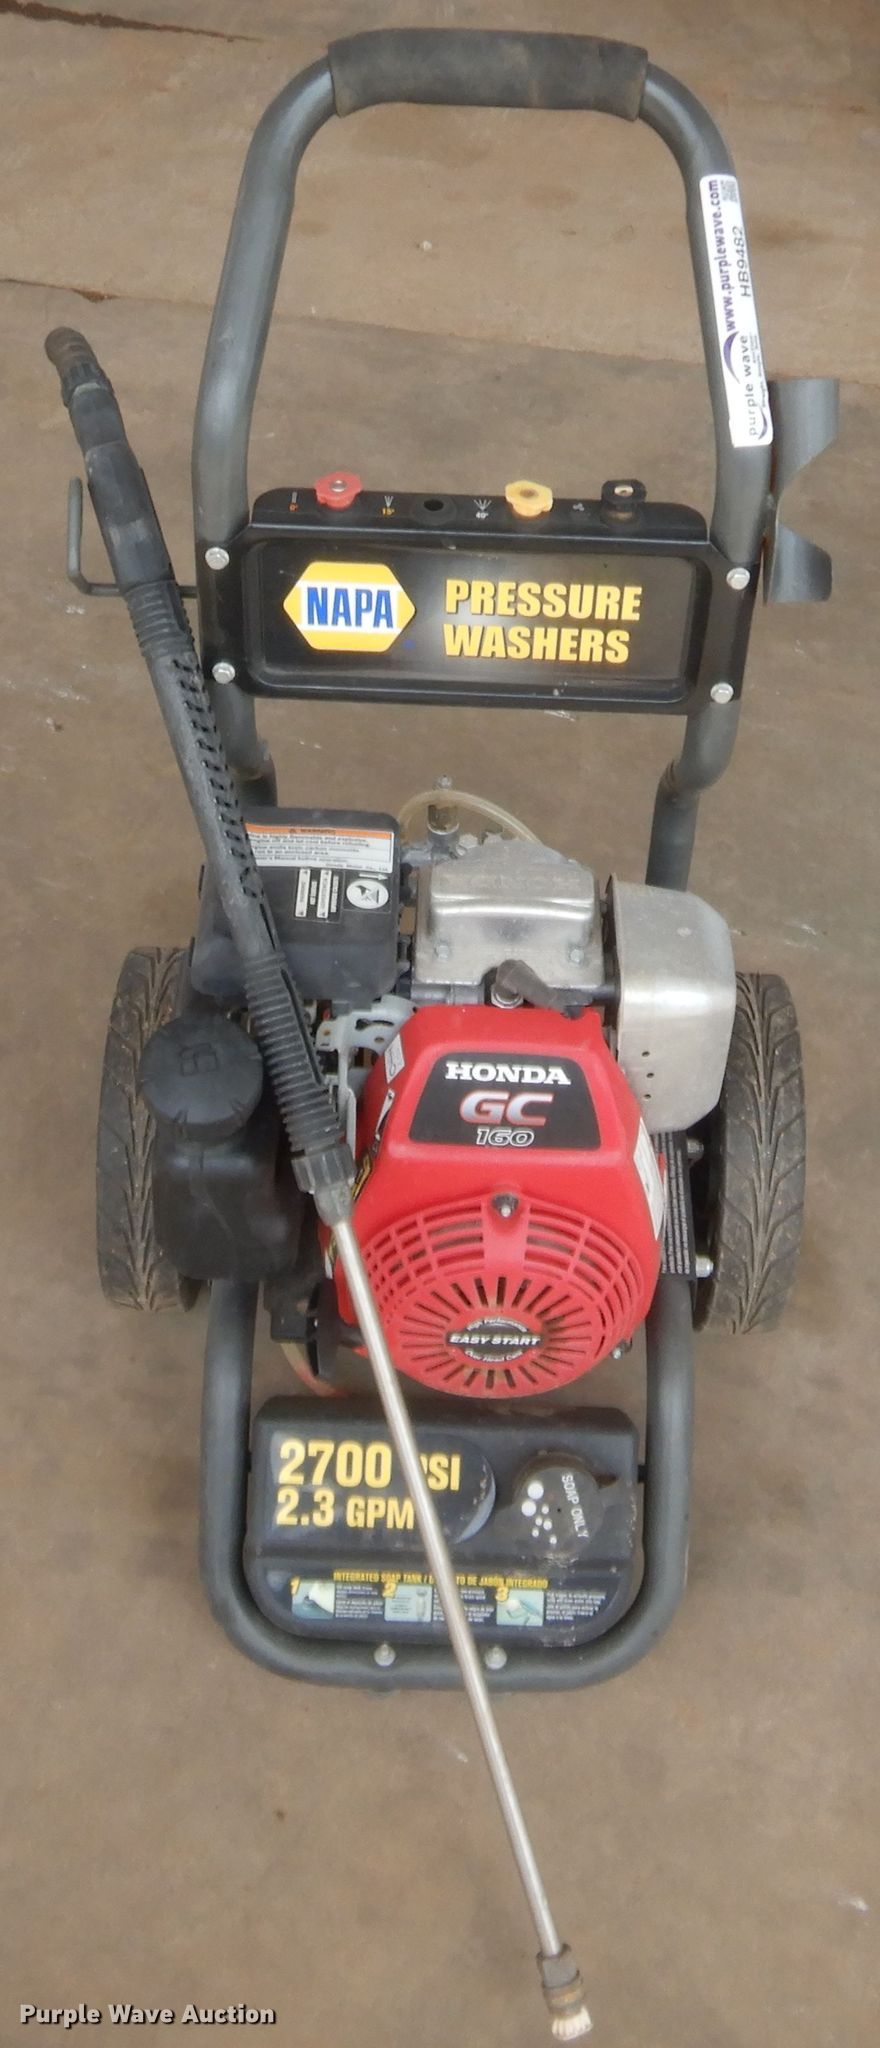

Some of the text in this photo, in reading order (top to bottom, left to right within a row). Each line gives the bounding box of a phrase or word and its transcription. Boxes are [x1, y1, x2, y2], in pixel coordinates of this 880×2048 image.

[708, 180, 736, 332] www.purplewave.com
[732, 226, 751, 297] HB9482
[740, 335, 752, 377] wave
[745, 383, 760, 437] purple
[307, 586, 394, 629] NAPA
[446, 579, 643, 621] PRESSURE
[443, 623, 630, 664] WASHERS
[445, 1061, 571, 1085] HONDA
[459, 1090, 555, 1127] GC
[476, 1128, 535, 1147] 160
[449, 1334, 540, 1346] EASY START
[278, 1440, 392, 1488] 2700
[276, 1486, 415, 1530] 2.3 GPM
[562, 1474, 589, 1537] SOAP ONLY
[290, 1577, 300, 1595] 1
[333, 1571, 380, 1583] INTEGRATED
[380, 1572, 401, 1584] SOAP
[403, 1574, 422, 1585] TANK
[382, 1581, 397, 1598] 2
[495, 1586, 508, 1602] 3
